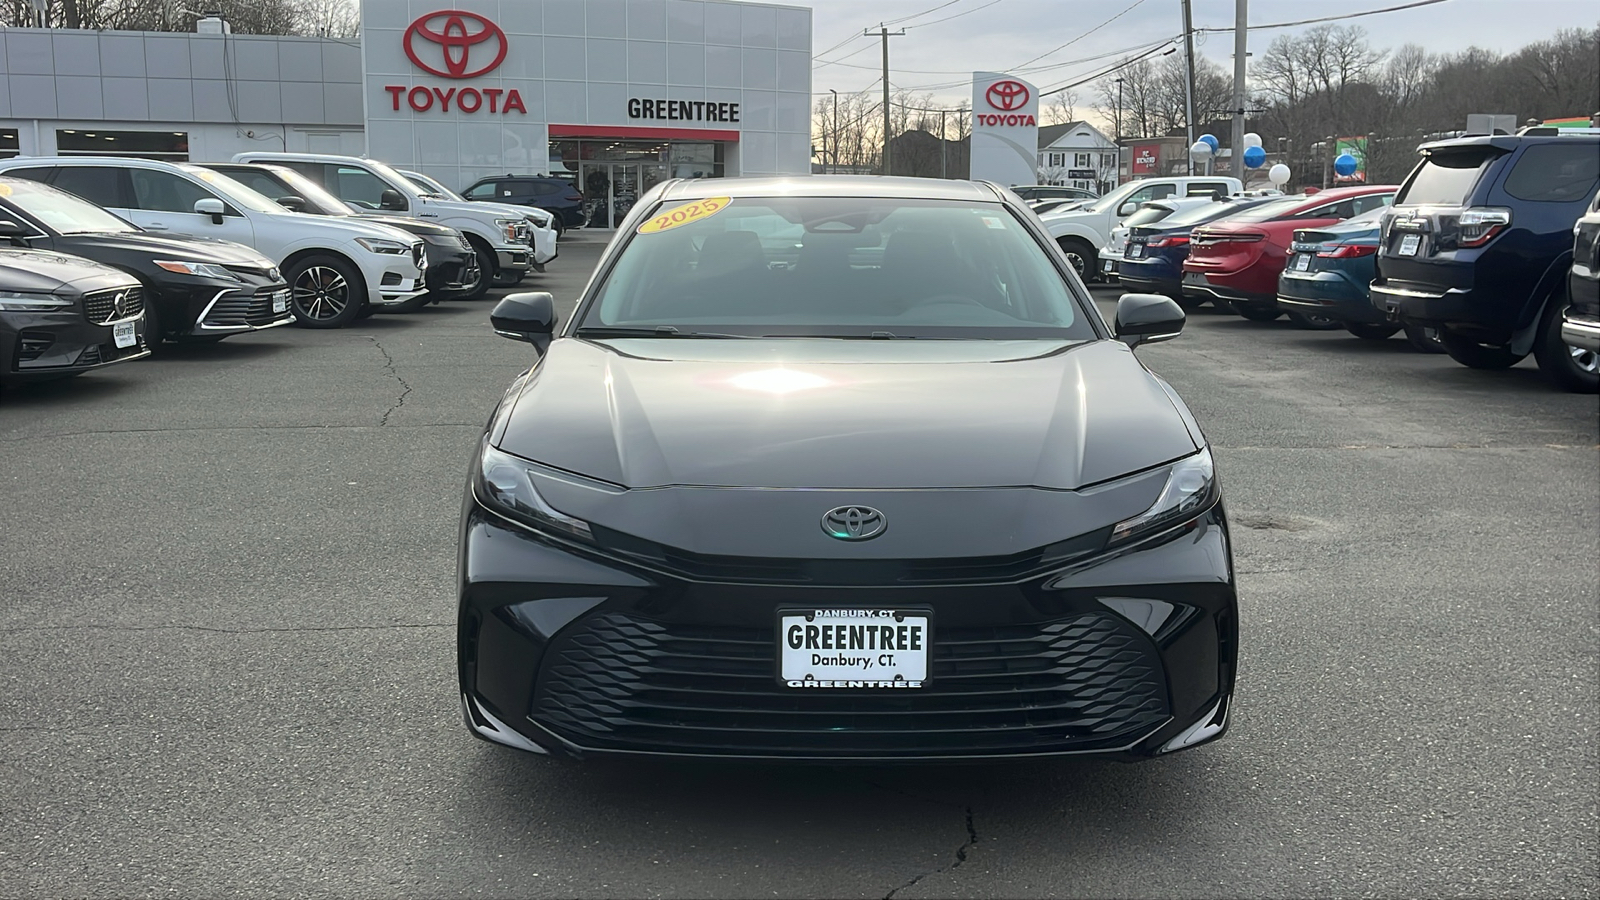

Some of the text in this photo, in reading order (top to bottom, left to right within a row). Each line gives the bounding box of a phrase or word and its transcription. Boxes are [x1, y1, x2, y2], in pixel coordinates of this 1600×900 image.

[385, 85, 527, 114] TOYOTA
[628, 97, 740, 123] GREENTREE
[977, 114, 1036, 127] TOYOTA
[656, 200, 719, 229] 2025
[878, 610, 895, 618] CT
[787, 624, 922, 650] GREENTREE
[812, 653, 896, 669] Danbury, CT.
[786, 680, 922, 688] GREENTREE
